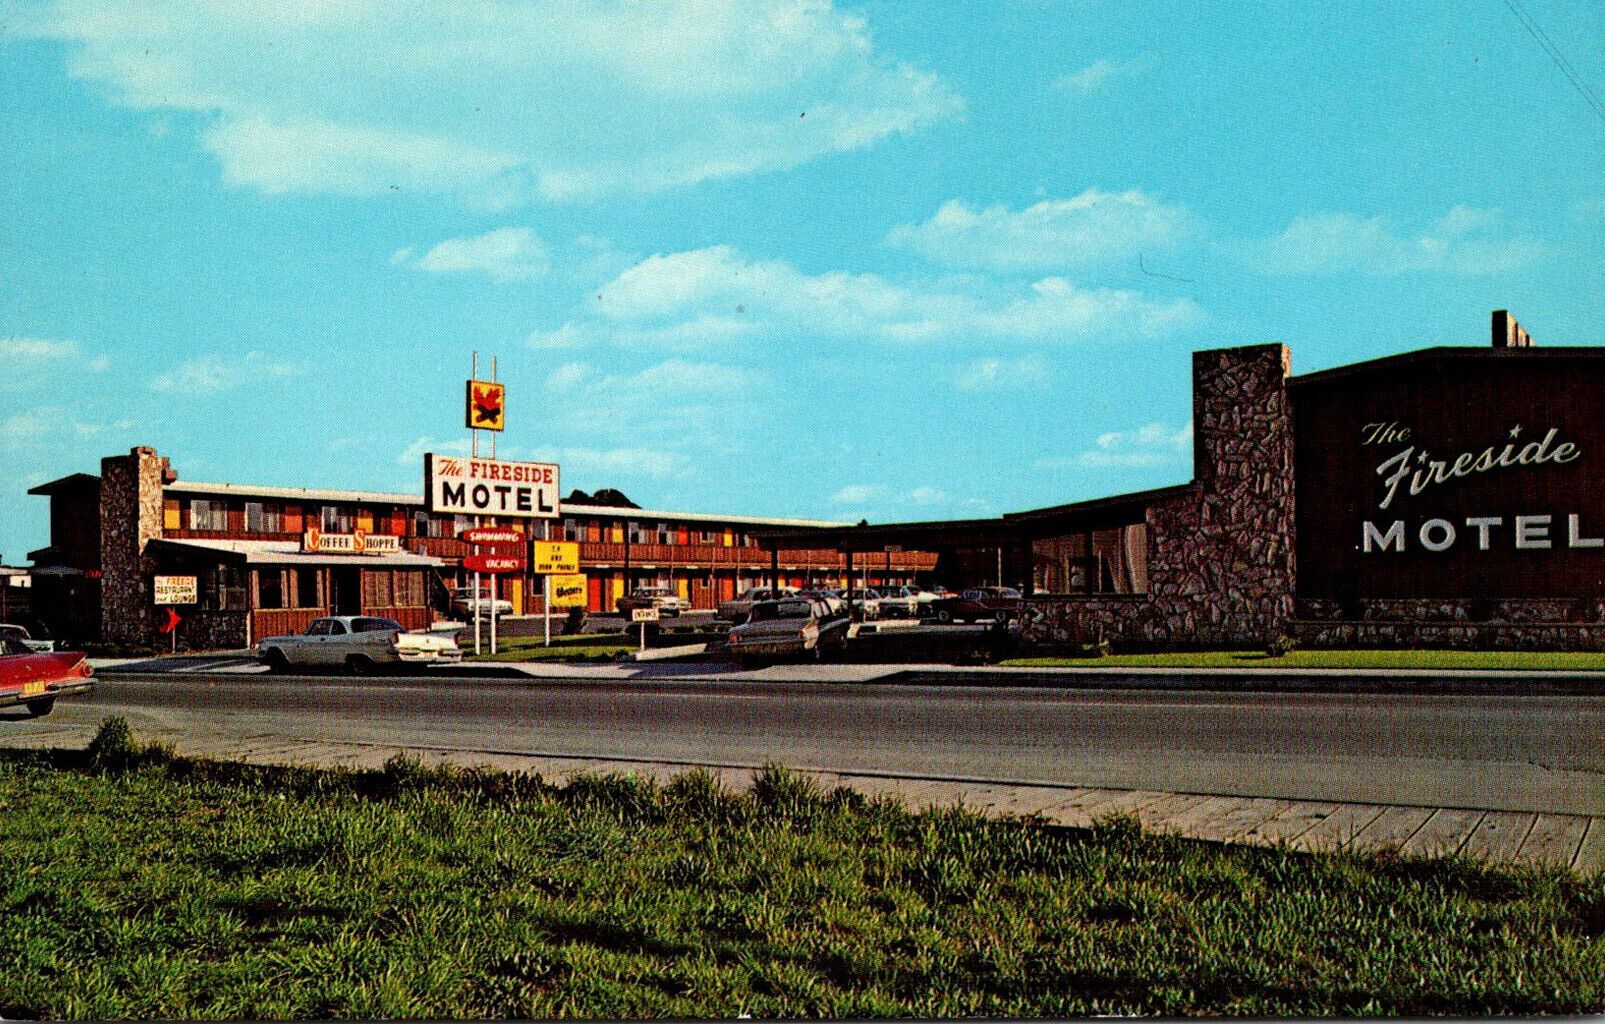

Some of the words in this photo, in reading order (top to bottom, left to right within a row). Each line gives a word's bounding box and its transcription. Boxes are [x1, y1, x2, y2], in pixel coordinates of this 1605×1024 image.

[1362, 421, 1411, 445] The
[438, 459, 463, 477] The
[470, 462, 553, 484] FIRESIDE
[1376, 424, 1581, 509] Fireside
[442, 481, 554, 513] MOTEL
[307, 527, 350, 549] COFFEE
[354, 529, 396, 549] SHOPPE
[1363, 513, 1604, 552] MOTEL
[485, 559, 519, 569] VACANCY
